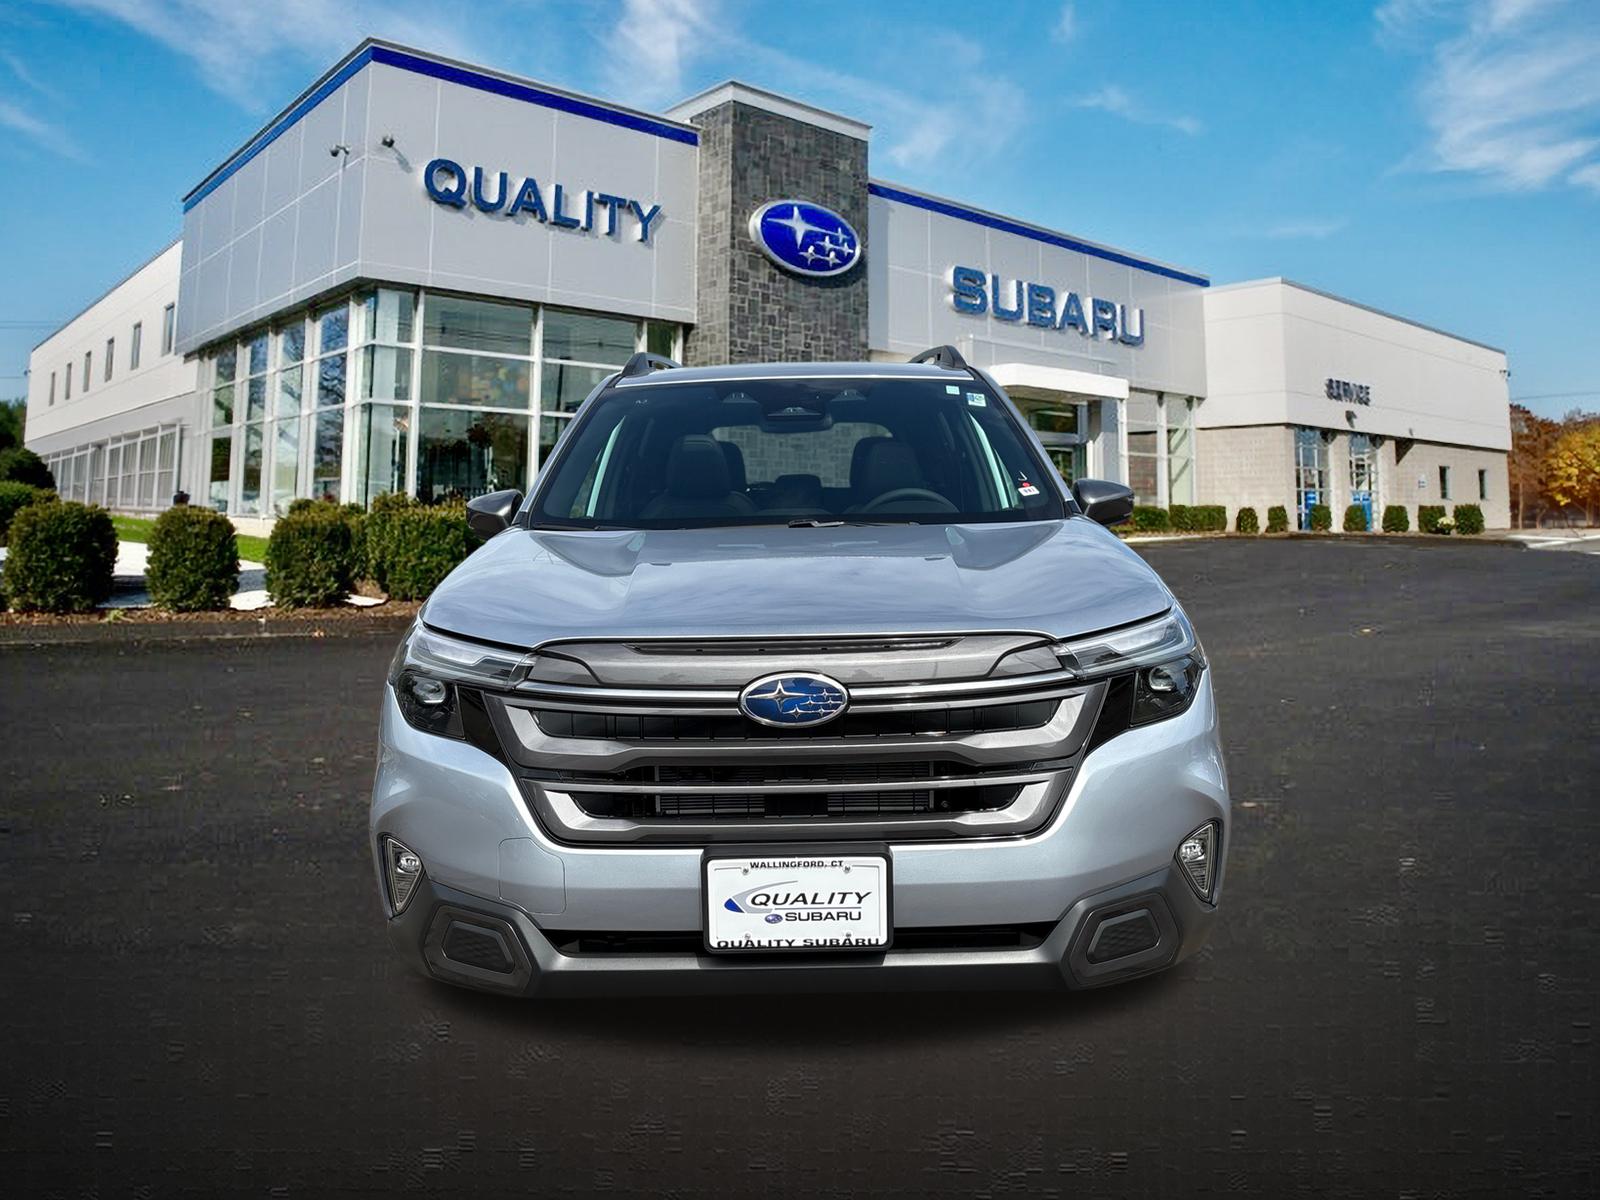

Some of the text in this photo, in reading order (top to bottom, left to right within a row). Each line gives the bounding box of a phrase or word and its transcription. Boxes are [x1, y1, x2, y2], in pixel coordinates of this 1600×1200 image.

[424, 158, 661, 243] QUALITY
[950, 265, 1145, 347] SUBARU
[1325, 377, 1371, 406] SERVICE
[830, 860, 844, 868] CT
[750, 891, 872, 906] QUALITY
[785, 911, 862, 921] SUBARU
[717, 938, 879, 948] QUALITY SUBARU
